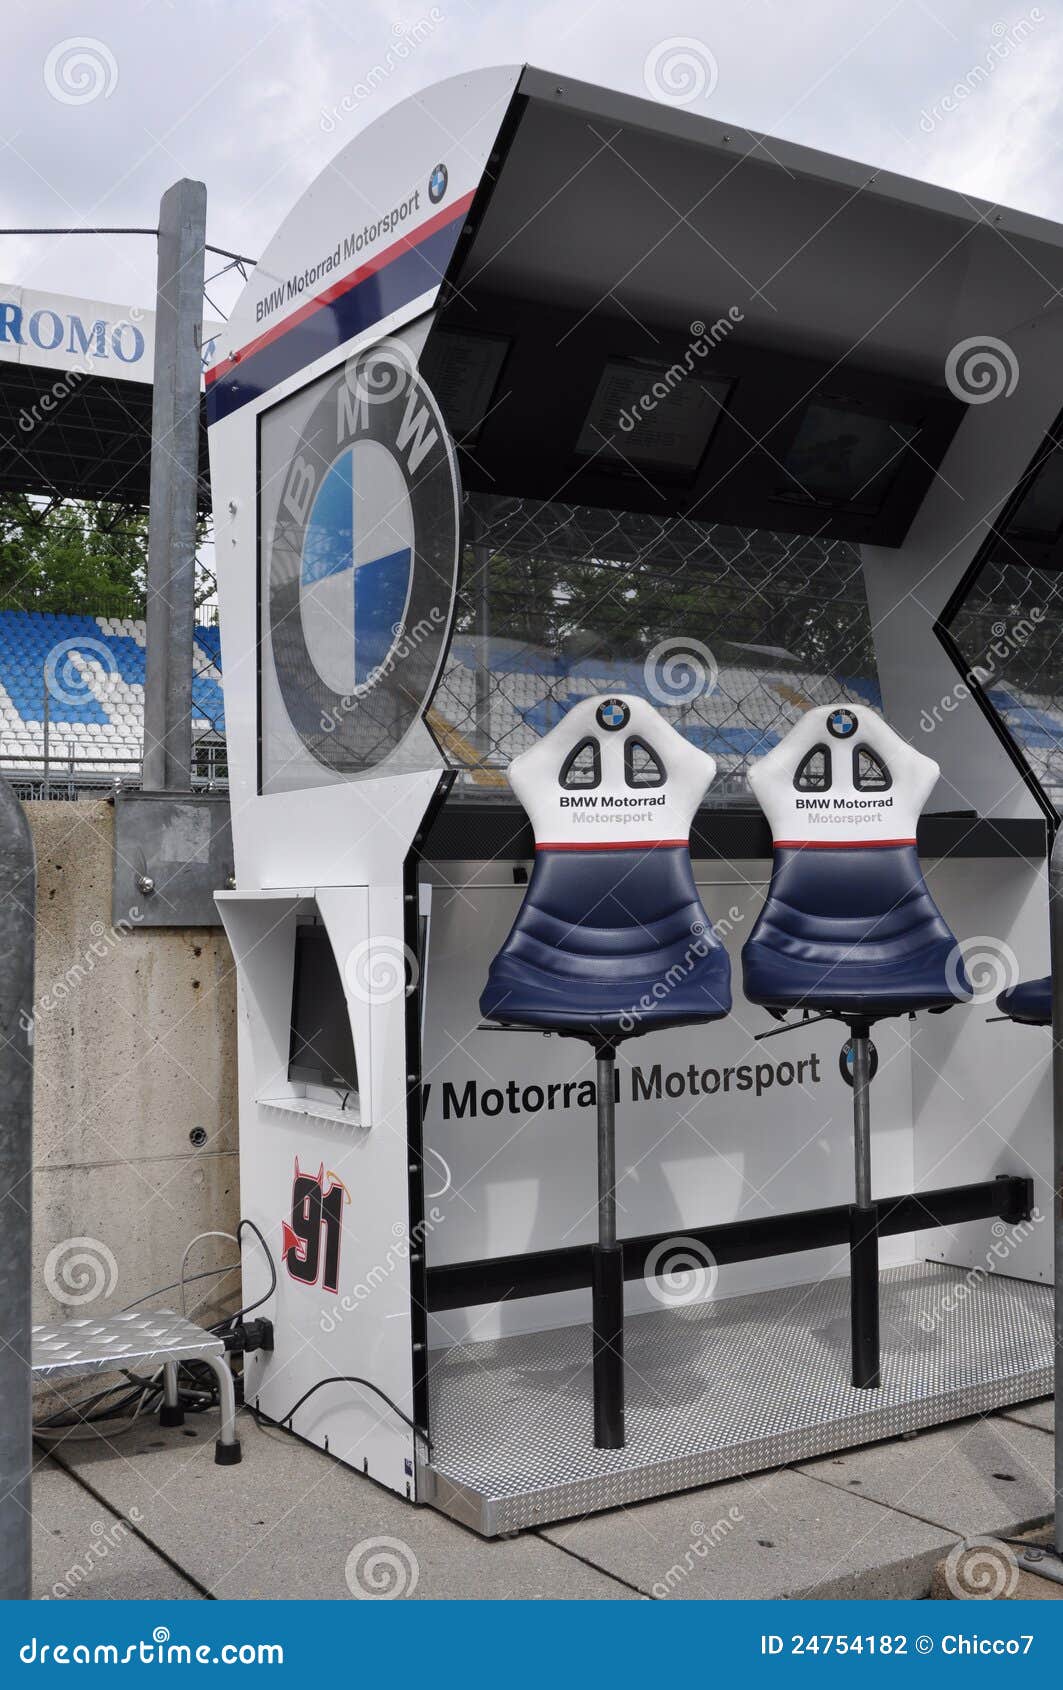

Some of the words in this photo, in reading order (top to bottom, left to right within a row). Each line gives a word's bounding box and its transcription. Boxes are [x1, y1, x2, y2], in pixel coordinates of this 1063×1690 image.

[256, 283, 285, 323] BMW
[286, 243, 341, 301] Motorrad
[343, 189, 420, 260] Motorsport
[0, 303, 145, 363] ROMO
[283, 371, 438, 527] BMW
[559, 797, 598, 807] BMW
[601, 795, 666, 807] Motorrad
[572, 811, 653, 824] Motorsport
[795, 799, 830, 809] BMW
[833, 797, 893, 809] Motorrad
[808, 813, 882, 824] Motorsport
[442, 1067, 621, 1121] Motorra
[631, 1053, 821, 1102] Motorsport
[283, 1171, 344, 1295] 91
